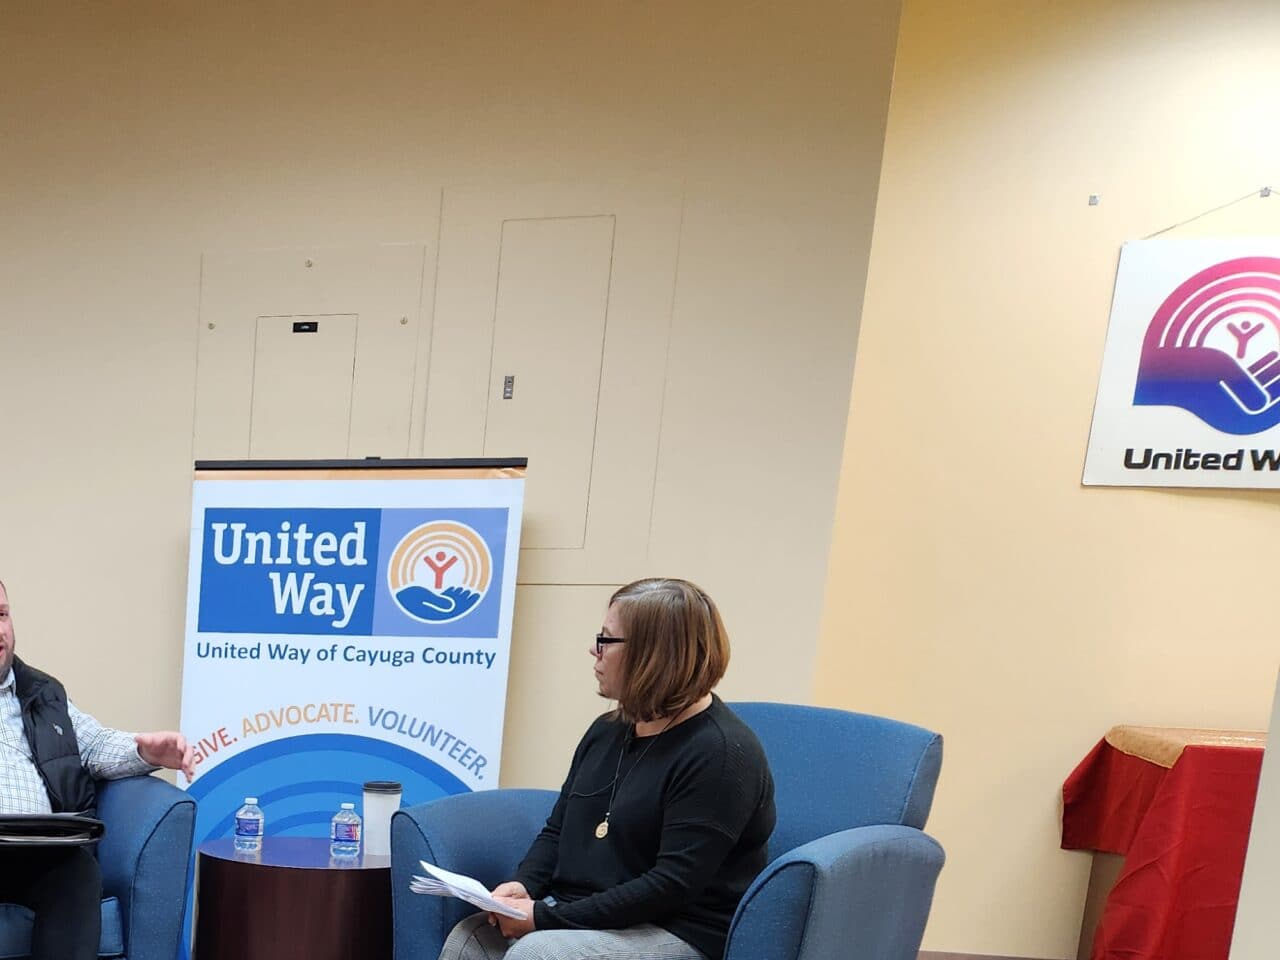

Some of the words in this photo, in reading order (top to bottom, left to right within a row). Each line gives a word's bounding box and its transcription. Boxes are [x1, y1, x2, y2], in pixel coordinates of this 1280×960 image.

[1123, 448, 1244, 471] United
[211, 520, 368, 566] United
[268, 572, 365, 629] Way
[196, 642, 261, 659] United
[267, 643, 310, 664] Way
[316, 644, 338, 661] of
[343, 645, 415, 667] Cayuga
[422, 647, 496, 669] County
[242, 703, 360, 738] ADVOCATE.
[368, 706, 488, 780] VOLUNTEER.
